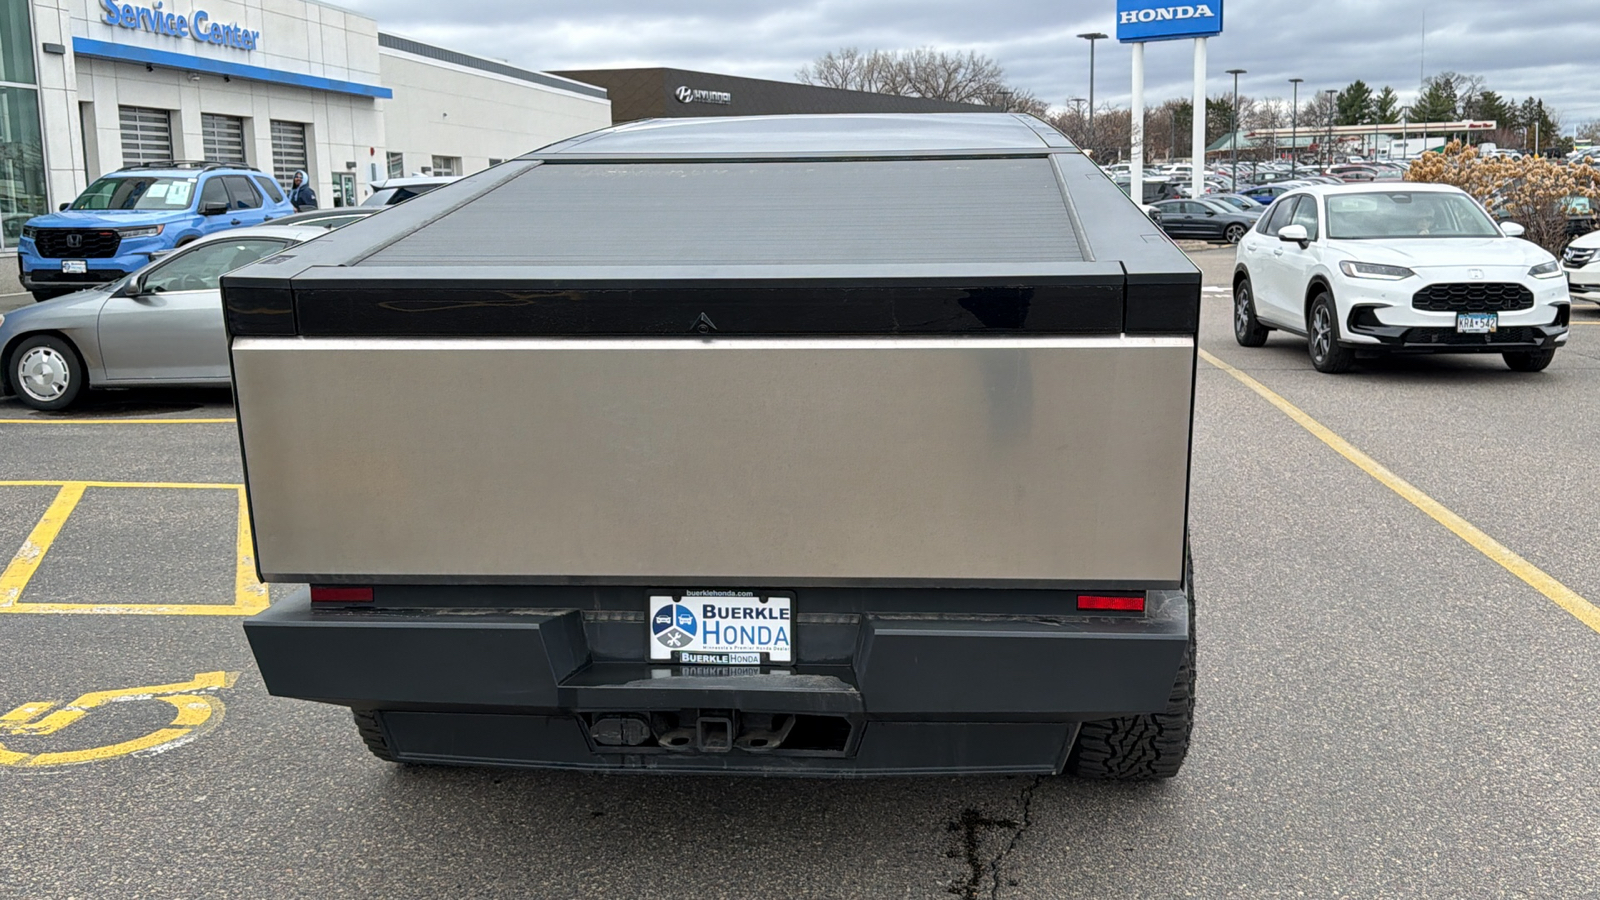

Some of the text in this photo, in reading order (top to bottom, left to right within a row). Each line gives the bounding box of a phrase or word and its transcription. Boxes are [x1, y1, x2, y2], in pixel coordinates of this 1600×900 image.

[1119, 4, 1215, 24] HONDA
[102, 0, 259, 51] Service Center
[693, 89, 731, 102] HYUNDAI
[1459, 318, 1495, 329] KRA 542
[702, 604, 790, 620] BUERKLE
[702, 620, 790, 646] HONDA
[681, 652, 758, 663] BUERKLE HONDA
